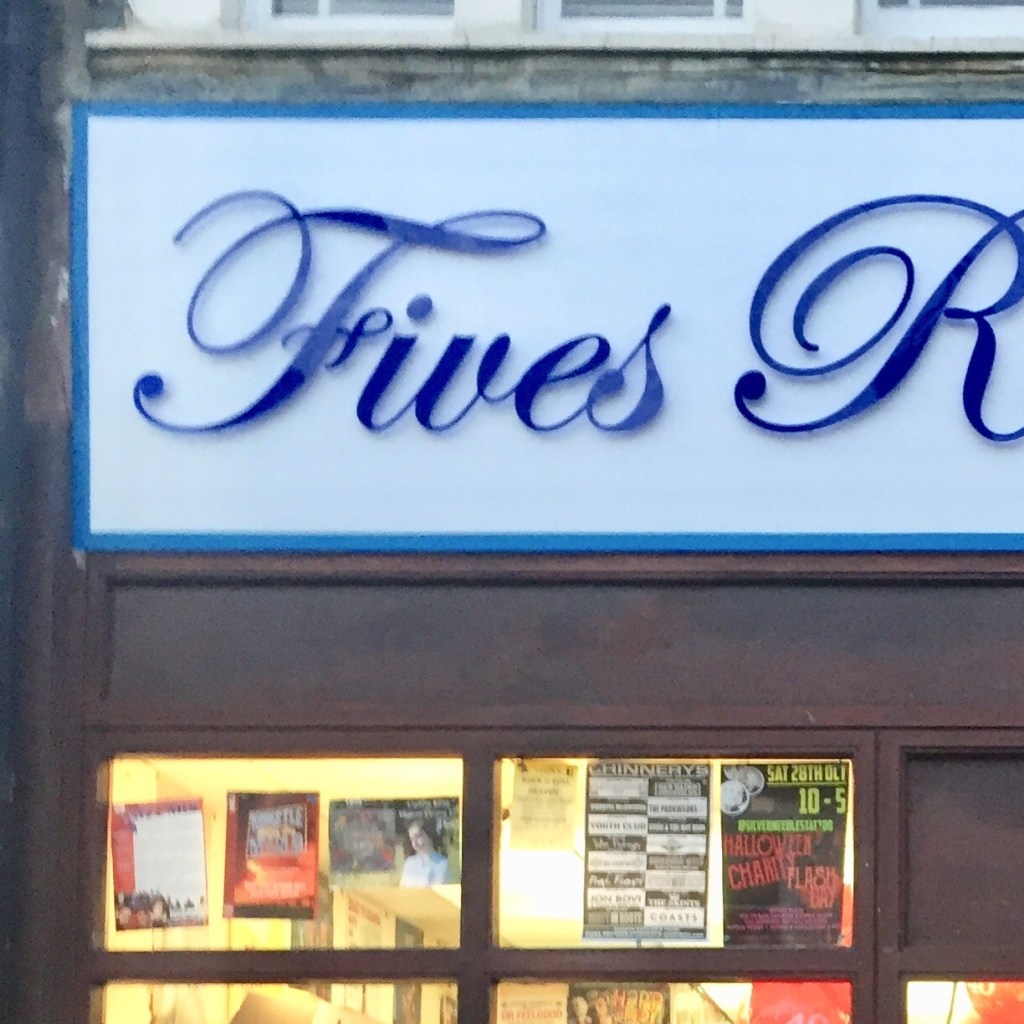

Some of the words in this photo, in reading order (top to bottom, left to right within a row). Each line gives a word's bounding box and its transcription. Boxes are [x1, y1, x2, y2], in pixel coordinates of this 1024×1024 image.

[134, 189, 671, 433] Fives
[767, 764, 788, 782] SAT
[798, 787, 820, 815] 10
[835, 787, 846, 814] 5
[650, 913, 698, 922] COASTS
